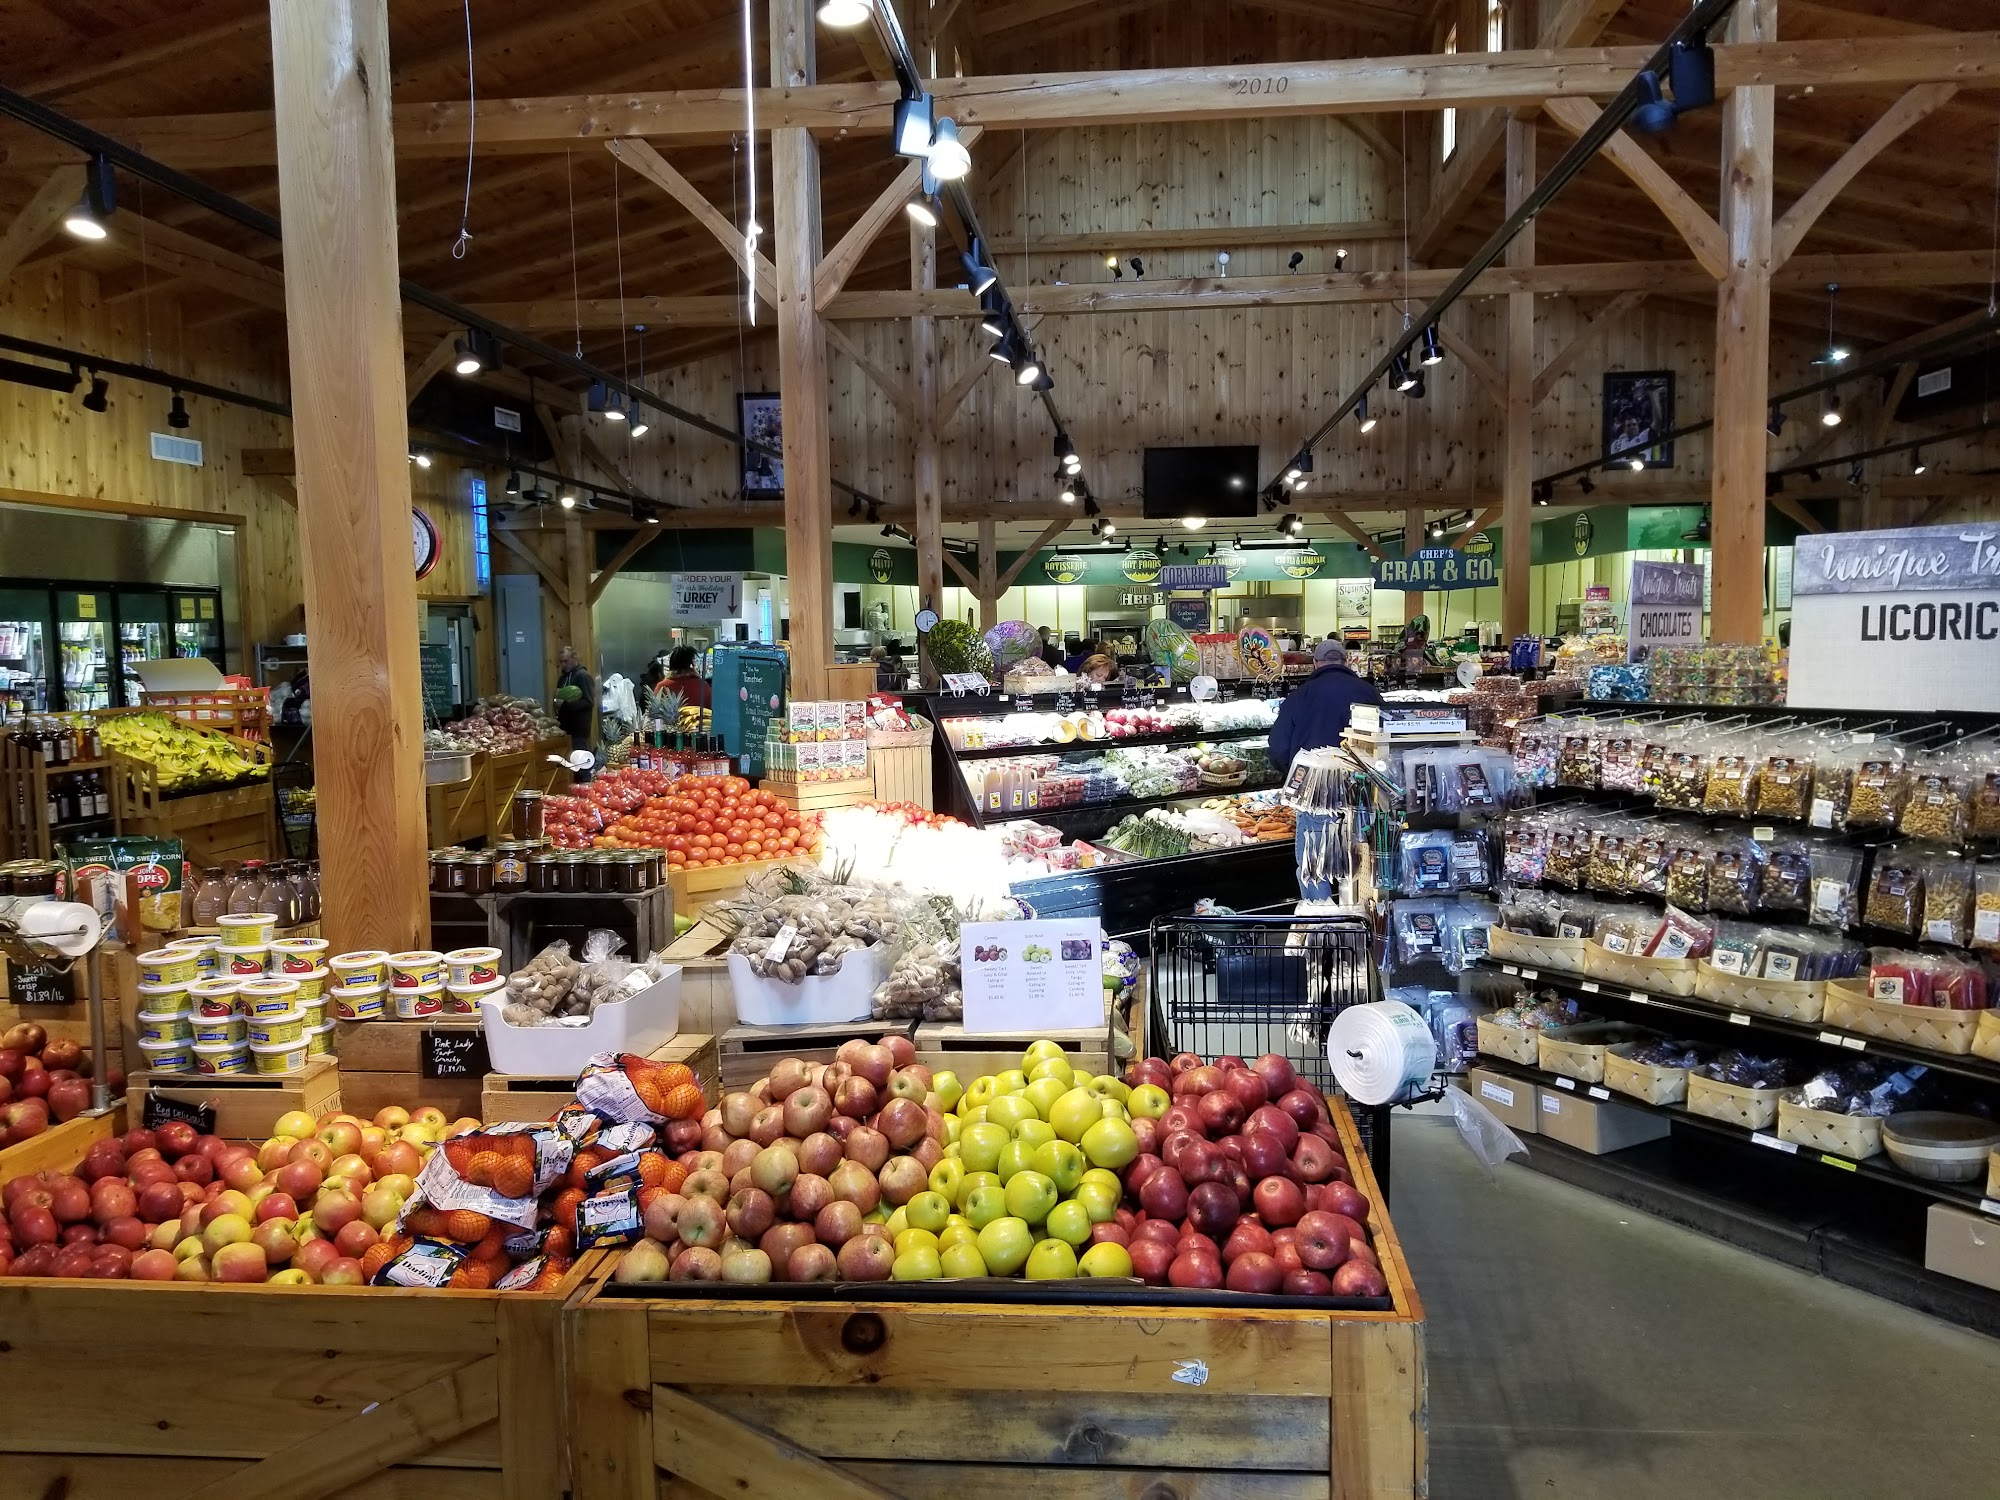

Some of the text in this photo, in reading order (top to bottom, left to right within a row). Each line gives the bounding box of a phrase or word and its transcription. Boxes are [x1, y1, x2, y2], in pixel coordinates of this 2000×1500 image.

[1236, 76, 1288, 95] 2010
[1420, 549, 1454, 560] CHEF'S
[1122, 560, 1162, 570] HOT FOODS
[1381, 558, 1493, 582] GRAB & GO
[1821, 544, 1949, 588] Unique
[1162, 566, 1226, 585] CORNBREAD
[1640, 568, 1699, 601] Unique Treats
[676, 592, 718, 604] TURKEY
[1122, 591, 1164, 606] HERE
[1640, 612, 1692, 638] CHOCOLATES
[1861, 601, 1999, 641] LICORIC
[1414, 709, 1451, 718] Troyer
[85, 855, 107, 863] SWEET
[161, 853, 181, 861] CORN
[434, 1037, 474, 1052] Pink Lady
[155, 1103, 206, 1126] Red Delicious
